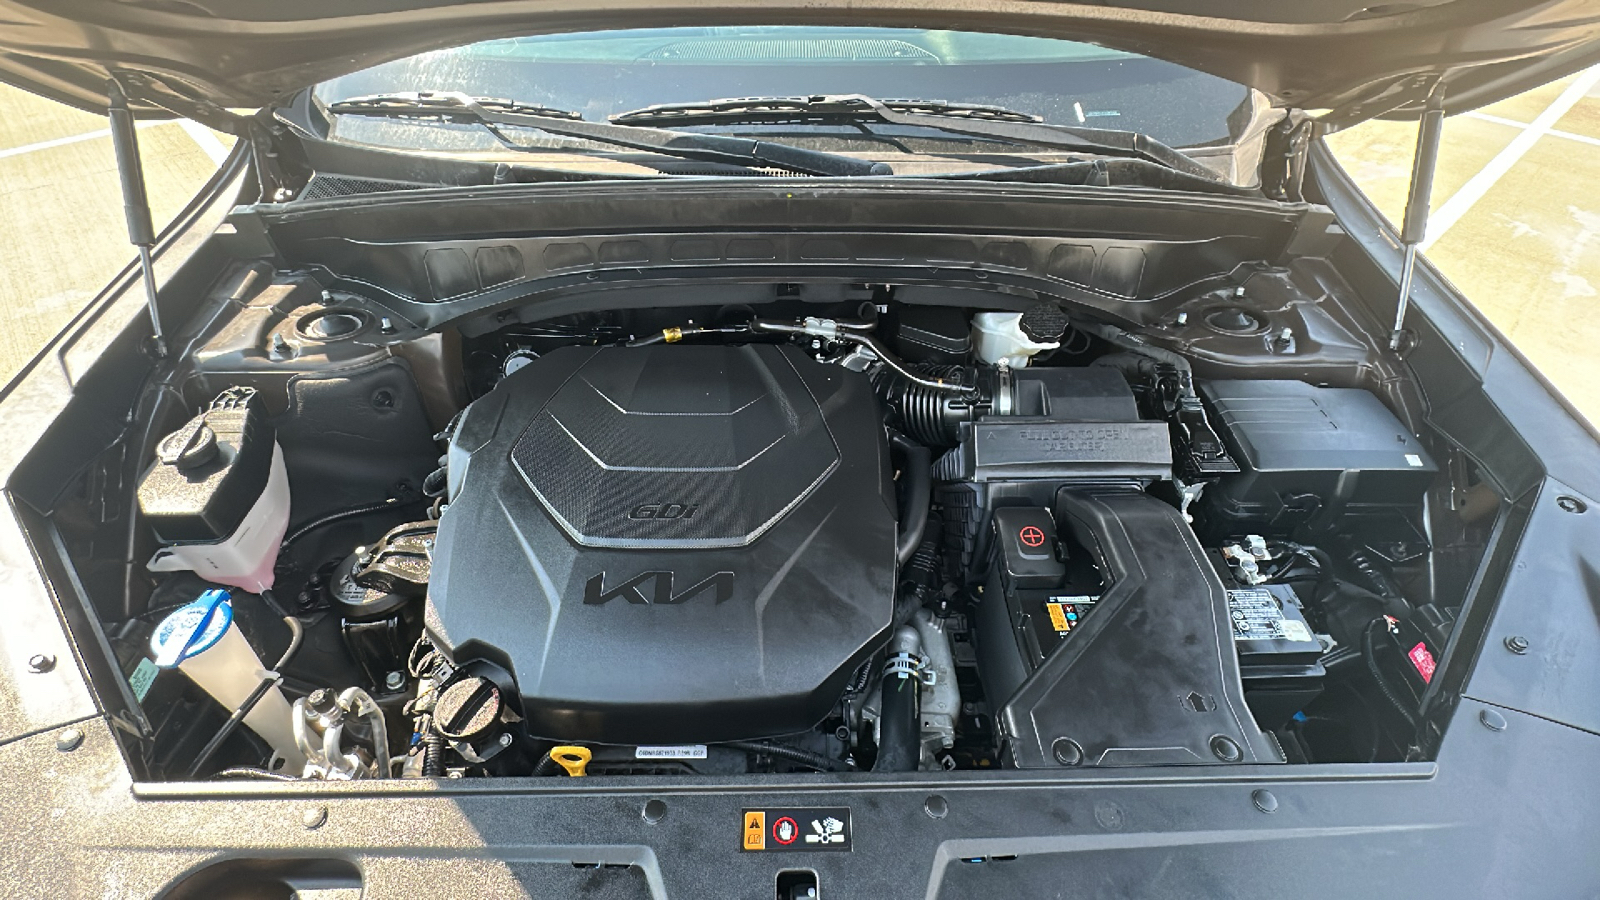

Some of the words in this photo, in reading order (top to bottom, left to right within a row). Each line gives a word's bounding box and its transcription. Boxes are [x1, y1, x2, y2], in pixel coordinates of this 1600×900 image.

[1019, 429, 1050, 441] PULL
[1097, 429, 1130, 440] OPEN
[583, 571, 735, 605] KIA
